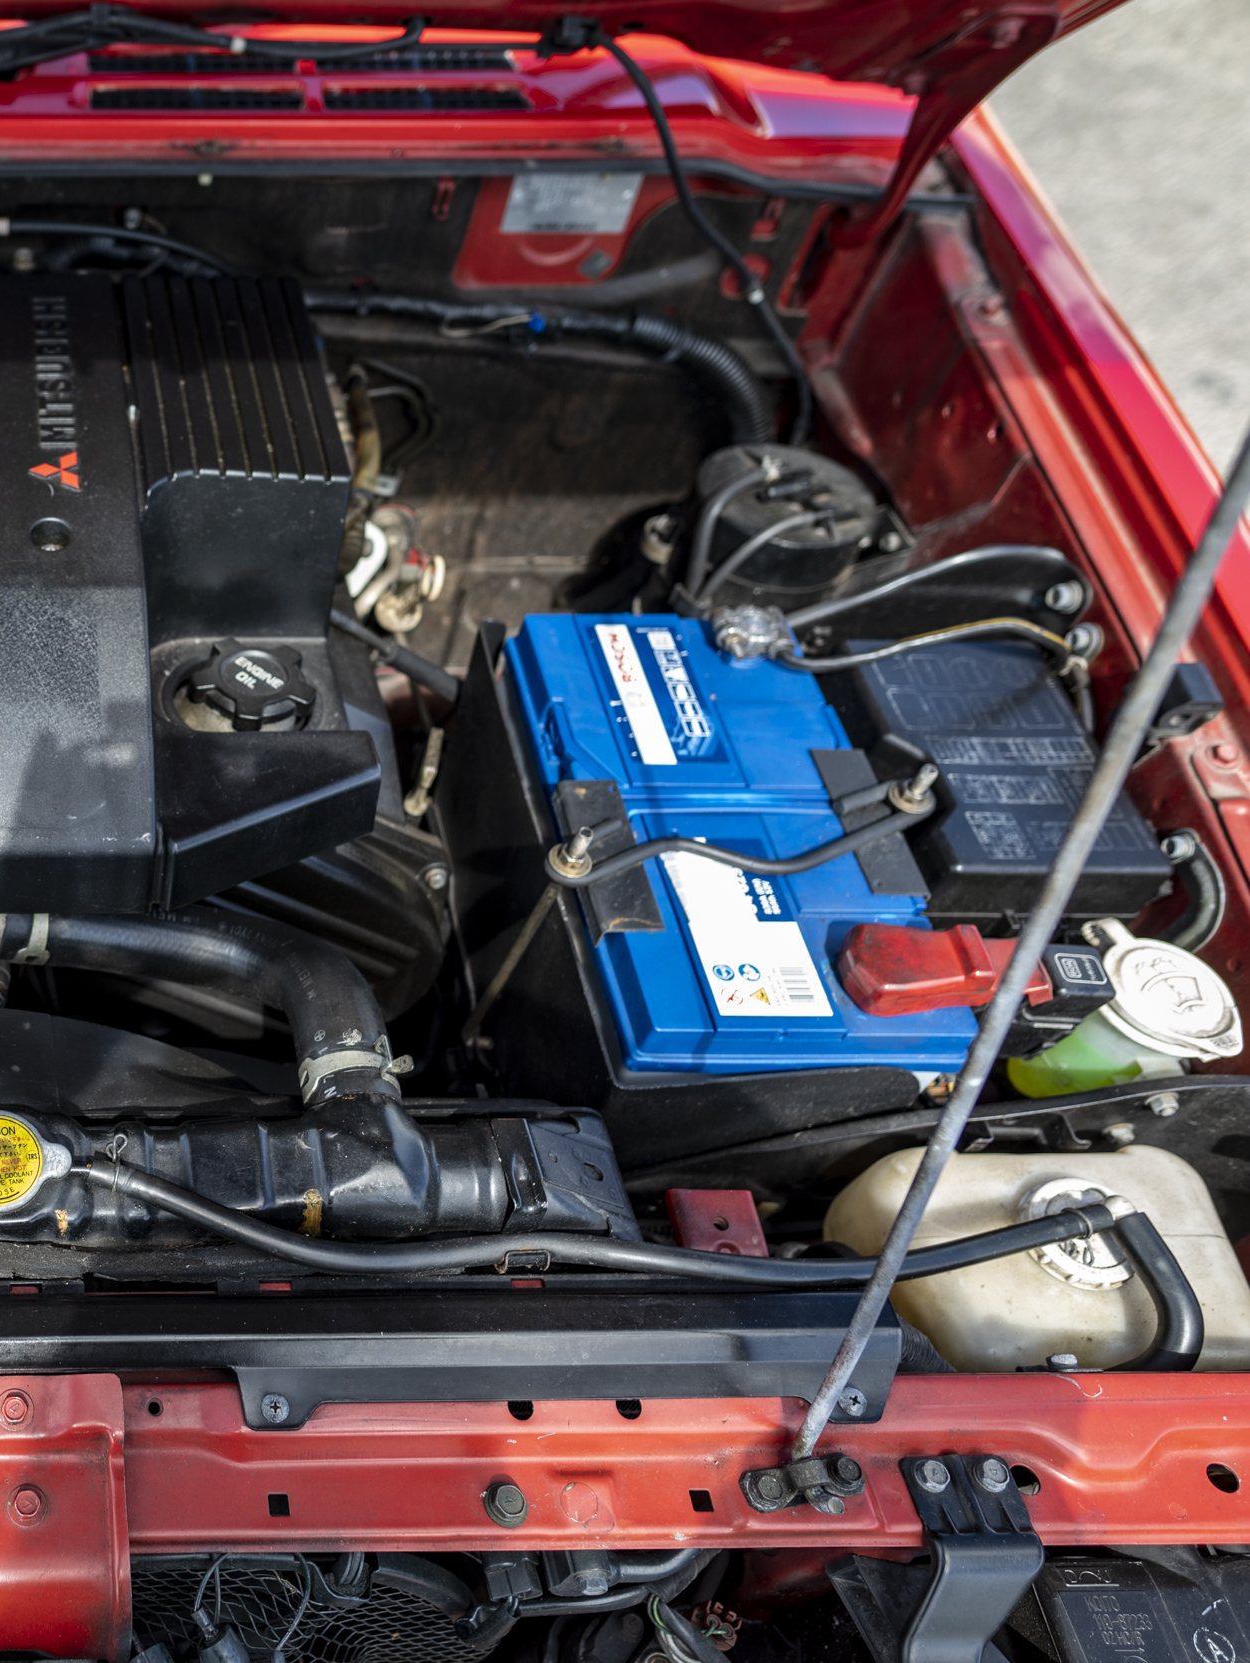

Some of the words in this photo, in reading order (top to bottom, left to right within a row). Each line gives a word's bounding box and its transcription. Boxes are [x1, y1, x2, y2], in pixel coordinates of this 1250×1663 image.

[32, 296, 78, 449] MITSUBISHI
[234, 655, 285, 690] ENGINE
[234, 671, 257, 690] OIL
[1, 1157, 22, 1166] NEVER
[4, 1170, 33, 1180] COOLANT
[1084, 1595, 1121, 1612] KOITO
[1092, 1613, 1154, 1631] 110-87233
